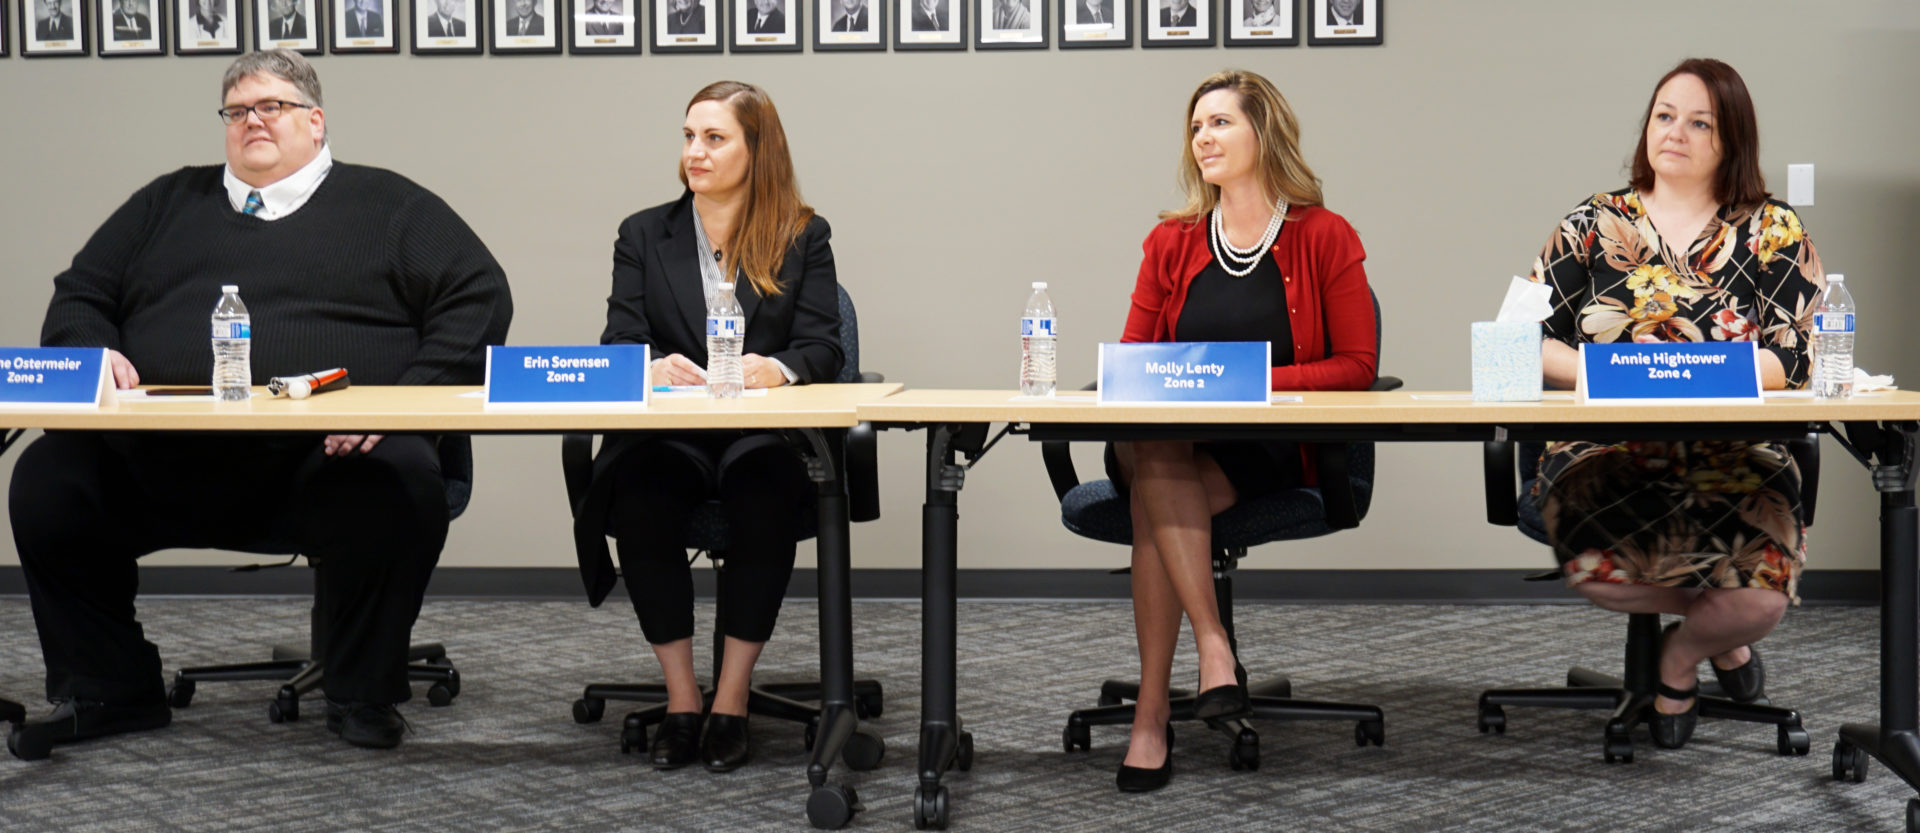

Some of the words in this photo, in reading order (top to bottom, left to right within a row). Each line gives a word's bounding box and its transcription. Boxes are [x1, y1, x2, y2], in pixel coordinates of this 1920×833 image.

[13, 357, 82, 370] Ostermeier
[524, 356, 549, 369] Erin
[552, 355, 610, 369] Sorensen
[1610, 352, 1651, 365] Annie
[1653, 352, 1727, 367] Hightower
[1145, 361, 1184, 377] Molly
[1186, 361, 1225, 377] Lenty
[1648, 367, 1680, 379] Zone
[1682, 368, 1692, 380] 4
[7, 371, 34, 383] Zone
[546, 371, 576, 382] Zone
[1164, 376, 1194, 388] Zone
[1196, 378, 1205, 388] 2
